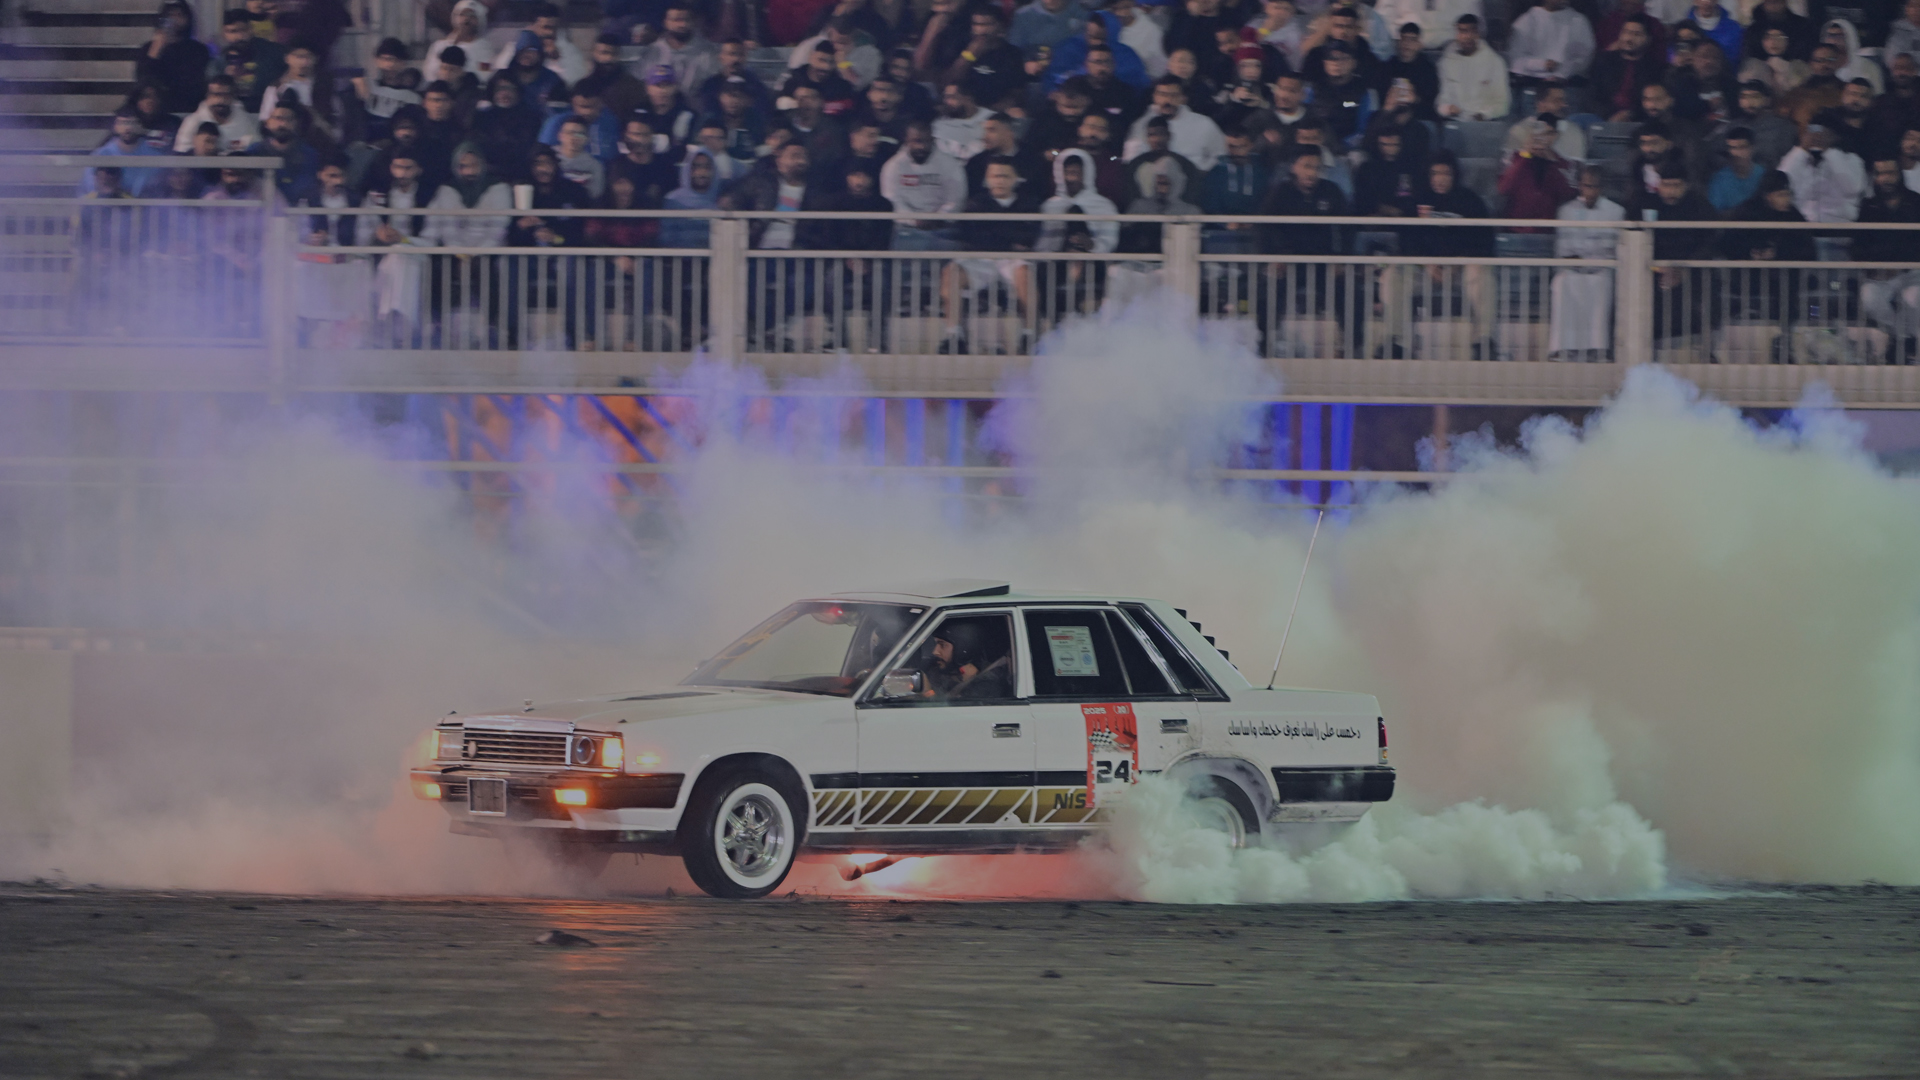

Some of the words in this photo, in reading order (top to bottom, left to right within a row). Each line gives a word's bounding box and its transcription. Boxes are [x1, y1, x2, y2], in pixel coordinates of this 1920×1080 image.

[1083, 707, 1107, 715] 2025
[1283, 721, 1300, 740] تعرف
[1097, 760, 1129, 784] 24
